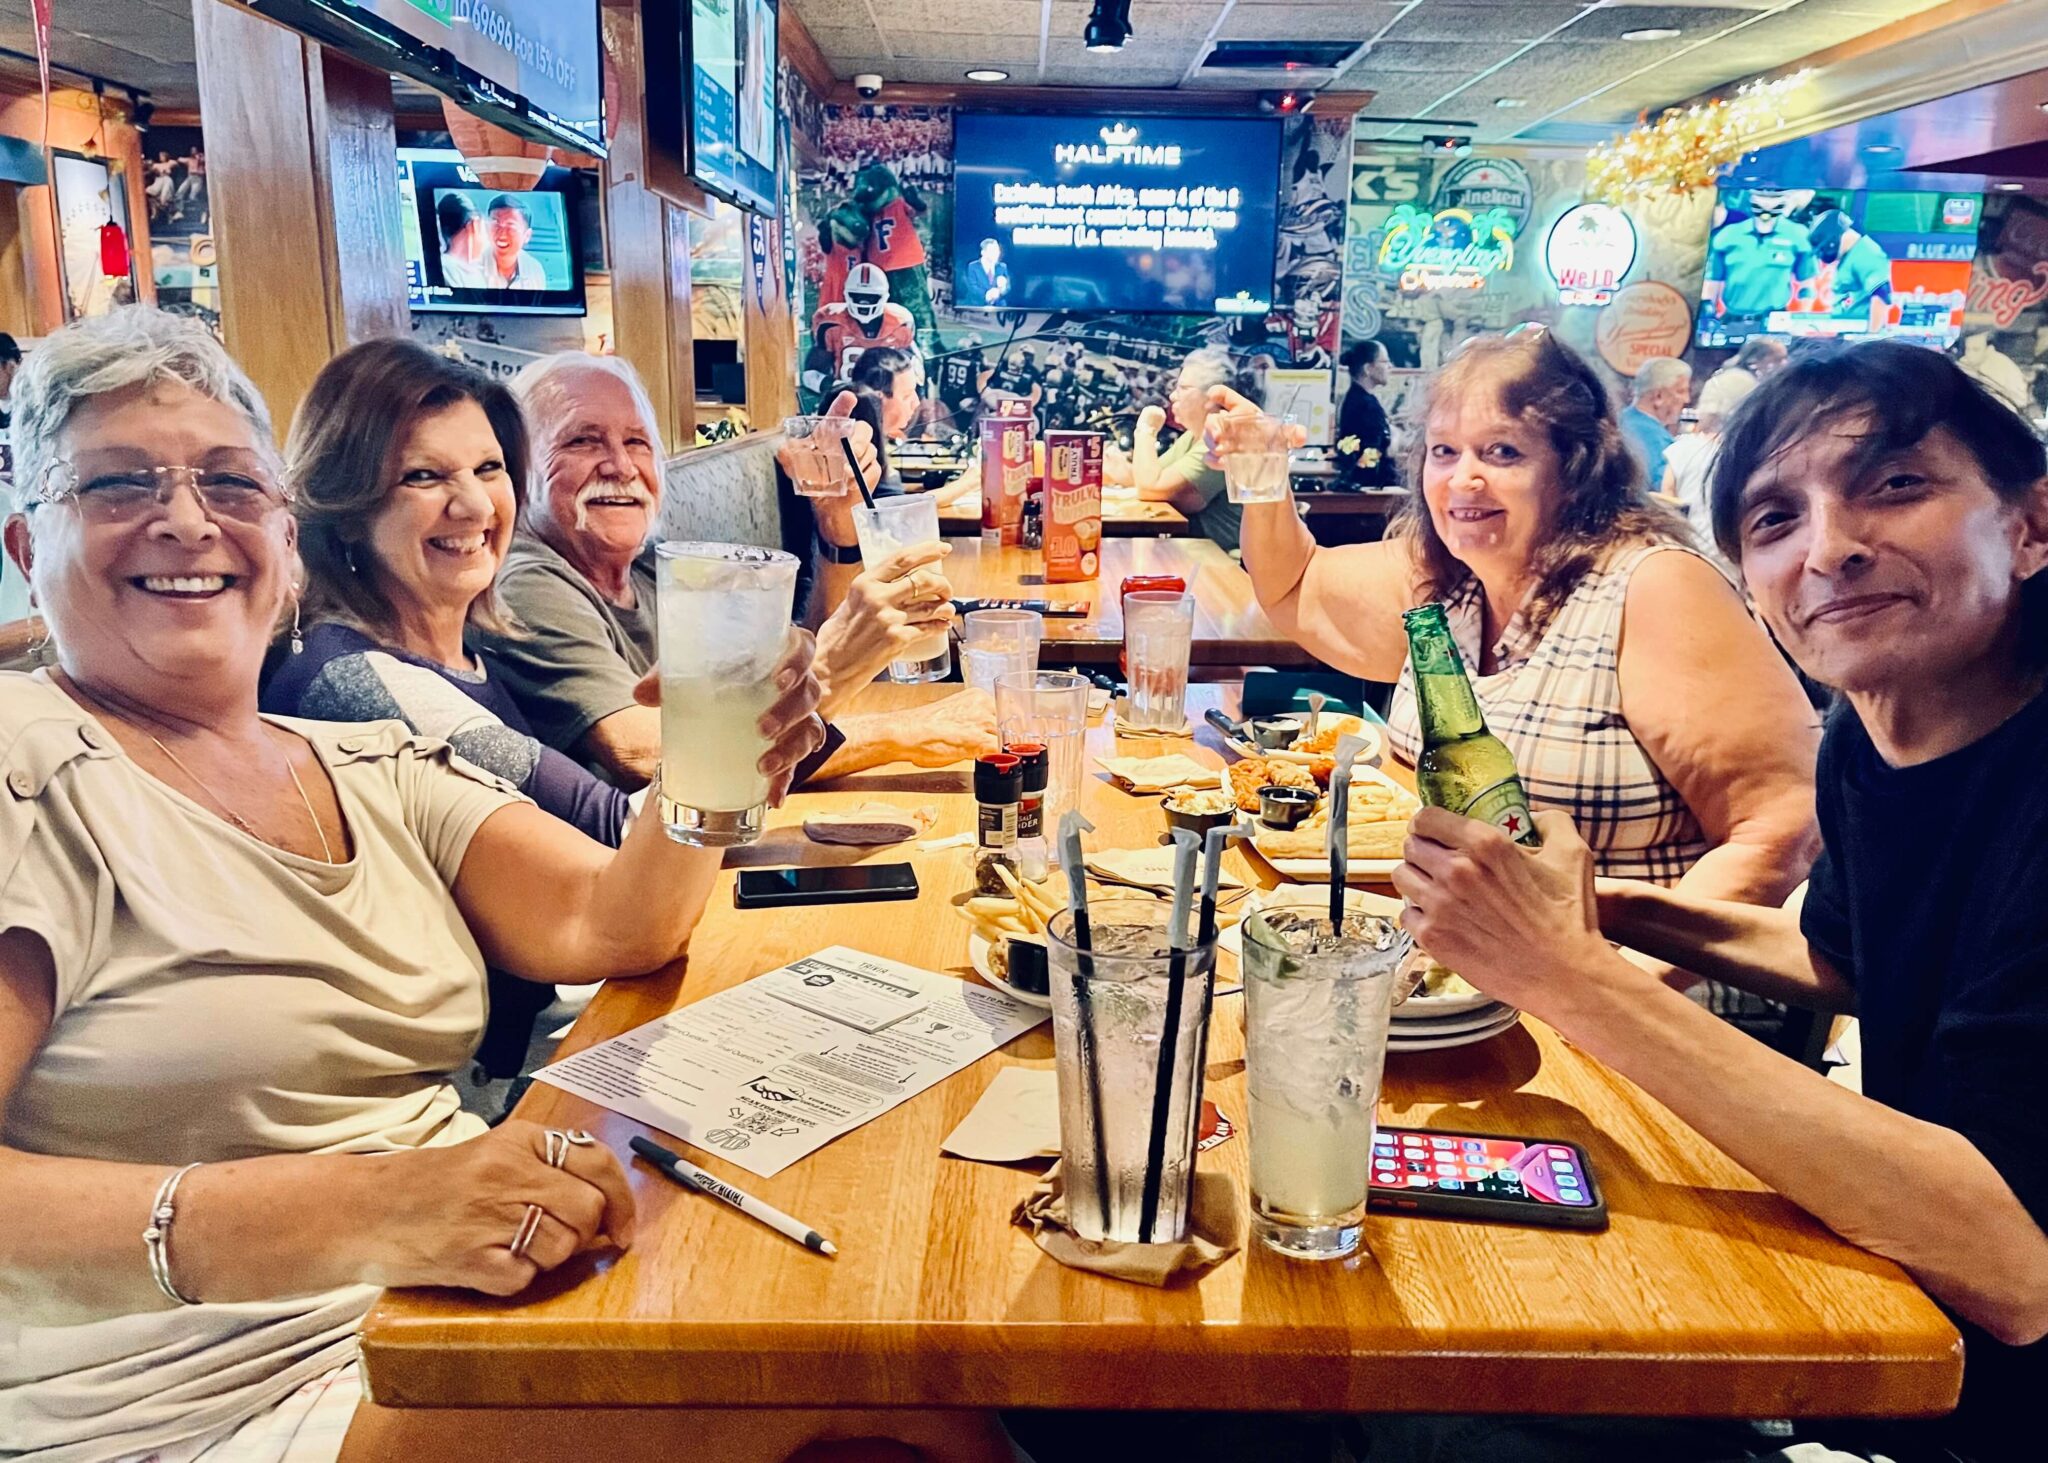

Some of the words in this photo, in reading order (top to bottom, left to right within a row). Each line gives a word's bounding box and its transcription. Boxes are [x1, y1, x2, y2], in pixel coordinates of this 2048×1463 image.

[514, 33, 533, 66] FOR
[536, 42, 554, 79] 15%
[556, 57, 577, 91] OFF
[1056, 144, 1181, 165] HALFTIME
[1056, 185, 1095, 205] South
[1464, 188, 1521, 207] ineken
[875, 218, 894, 250] F
[1380, 229, 1508, 275] Yuengling
[948, 365, 967, 385] 99
[1070, 450, 1078, 478] TRULY
[719, 1184, 744, 1207] TRIVIA
